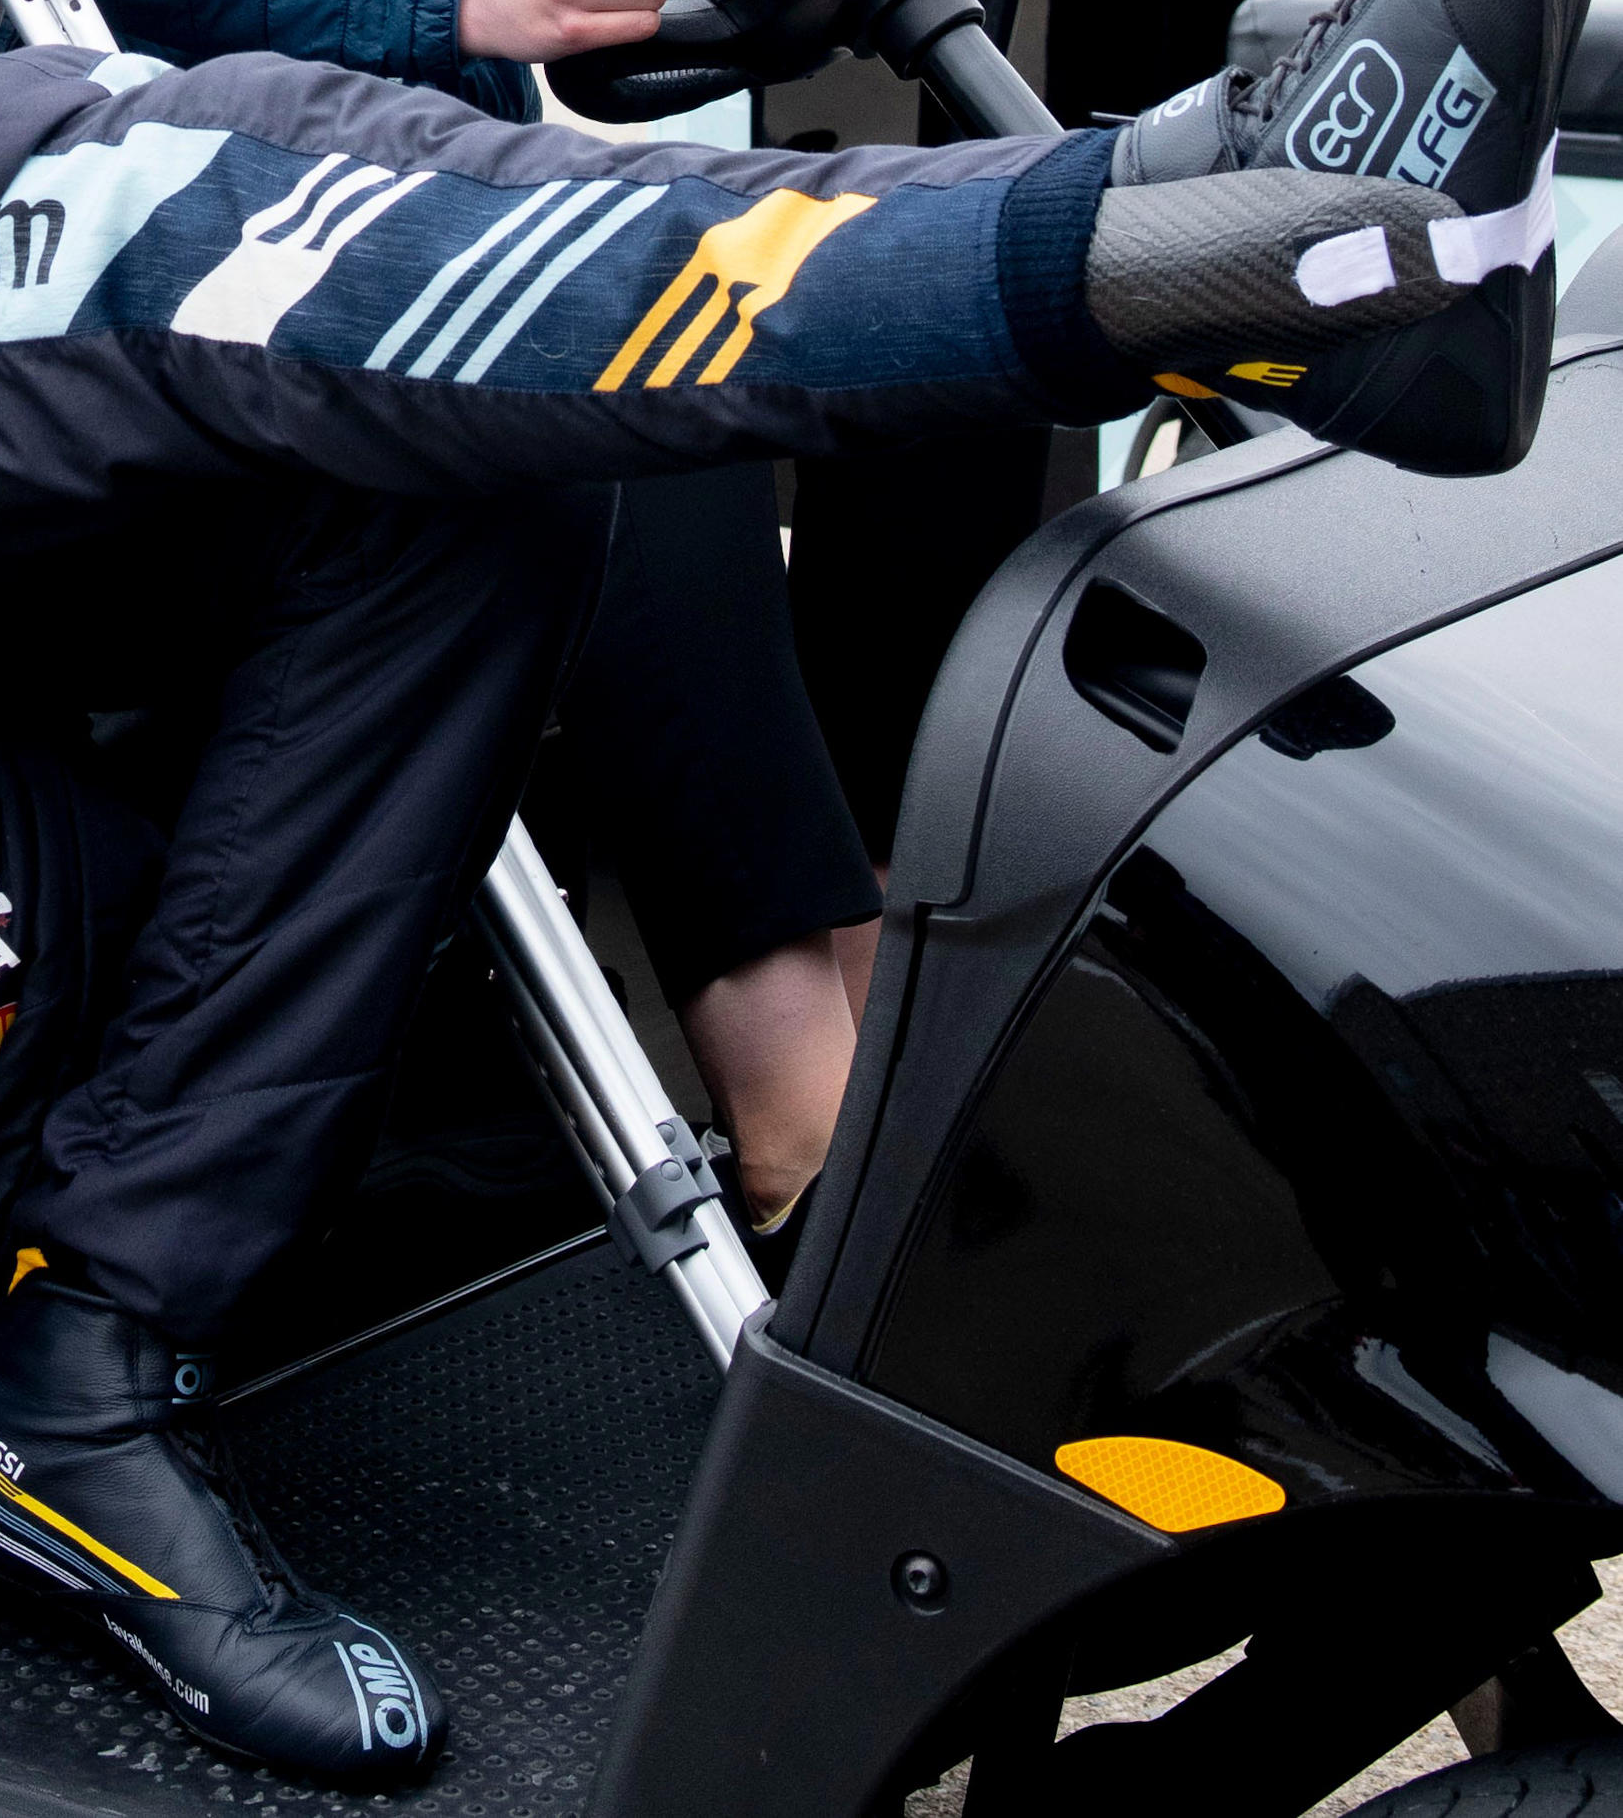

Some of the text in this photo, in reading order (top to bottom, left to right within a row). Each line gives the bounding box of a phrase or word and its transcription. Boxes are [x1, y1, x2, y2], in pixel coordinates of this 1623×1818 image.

[1308, 61, 1376, 168] ecr
[1397, 77, 1485, 188] LFG
[103, 1613, 210, 1715] JavaHouse.com
[349, 1643, 417, 1749] OMP
